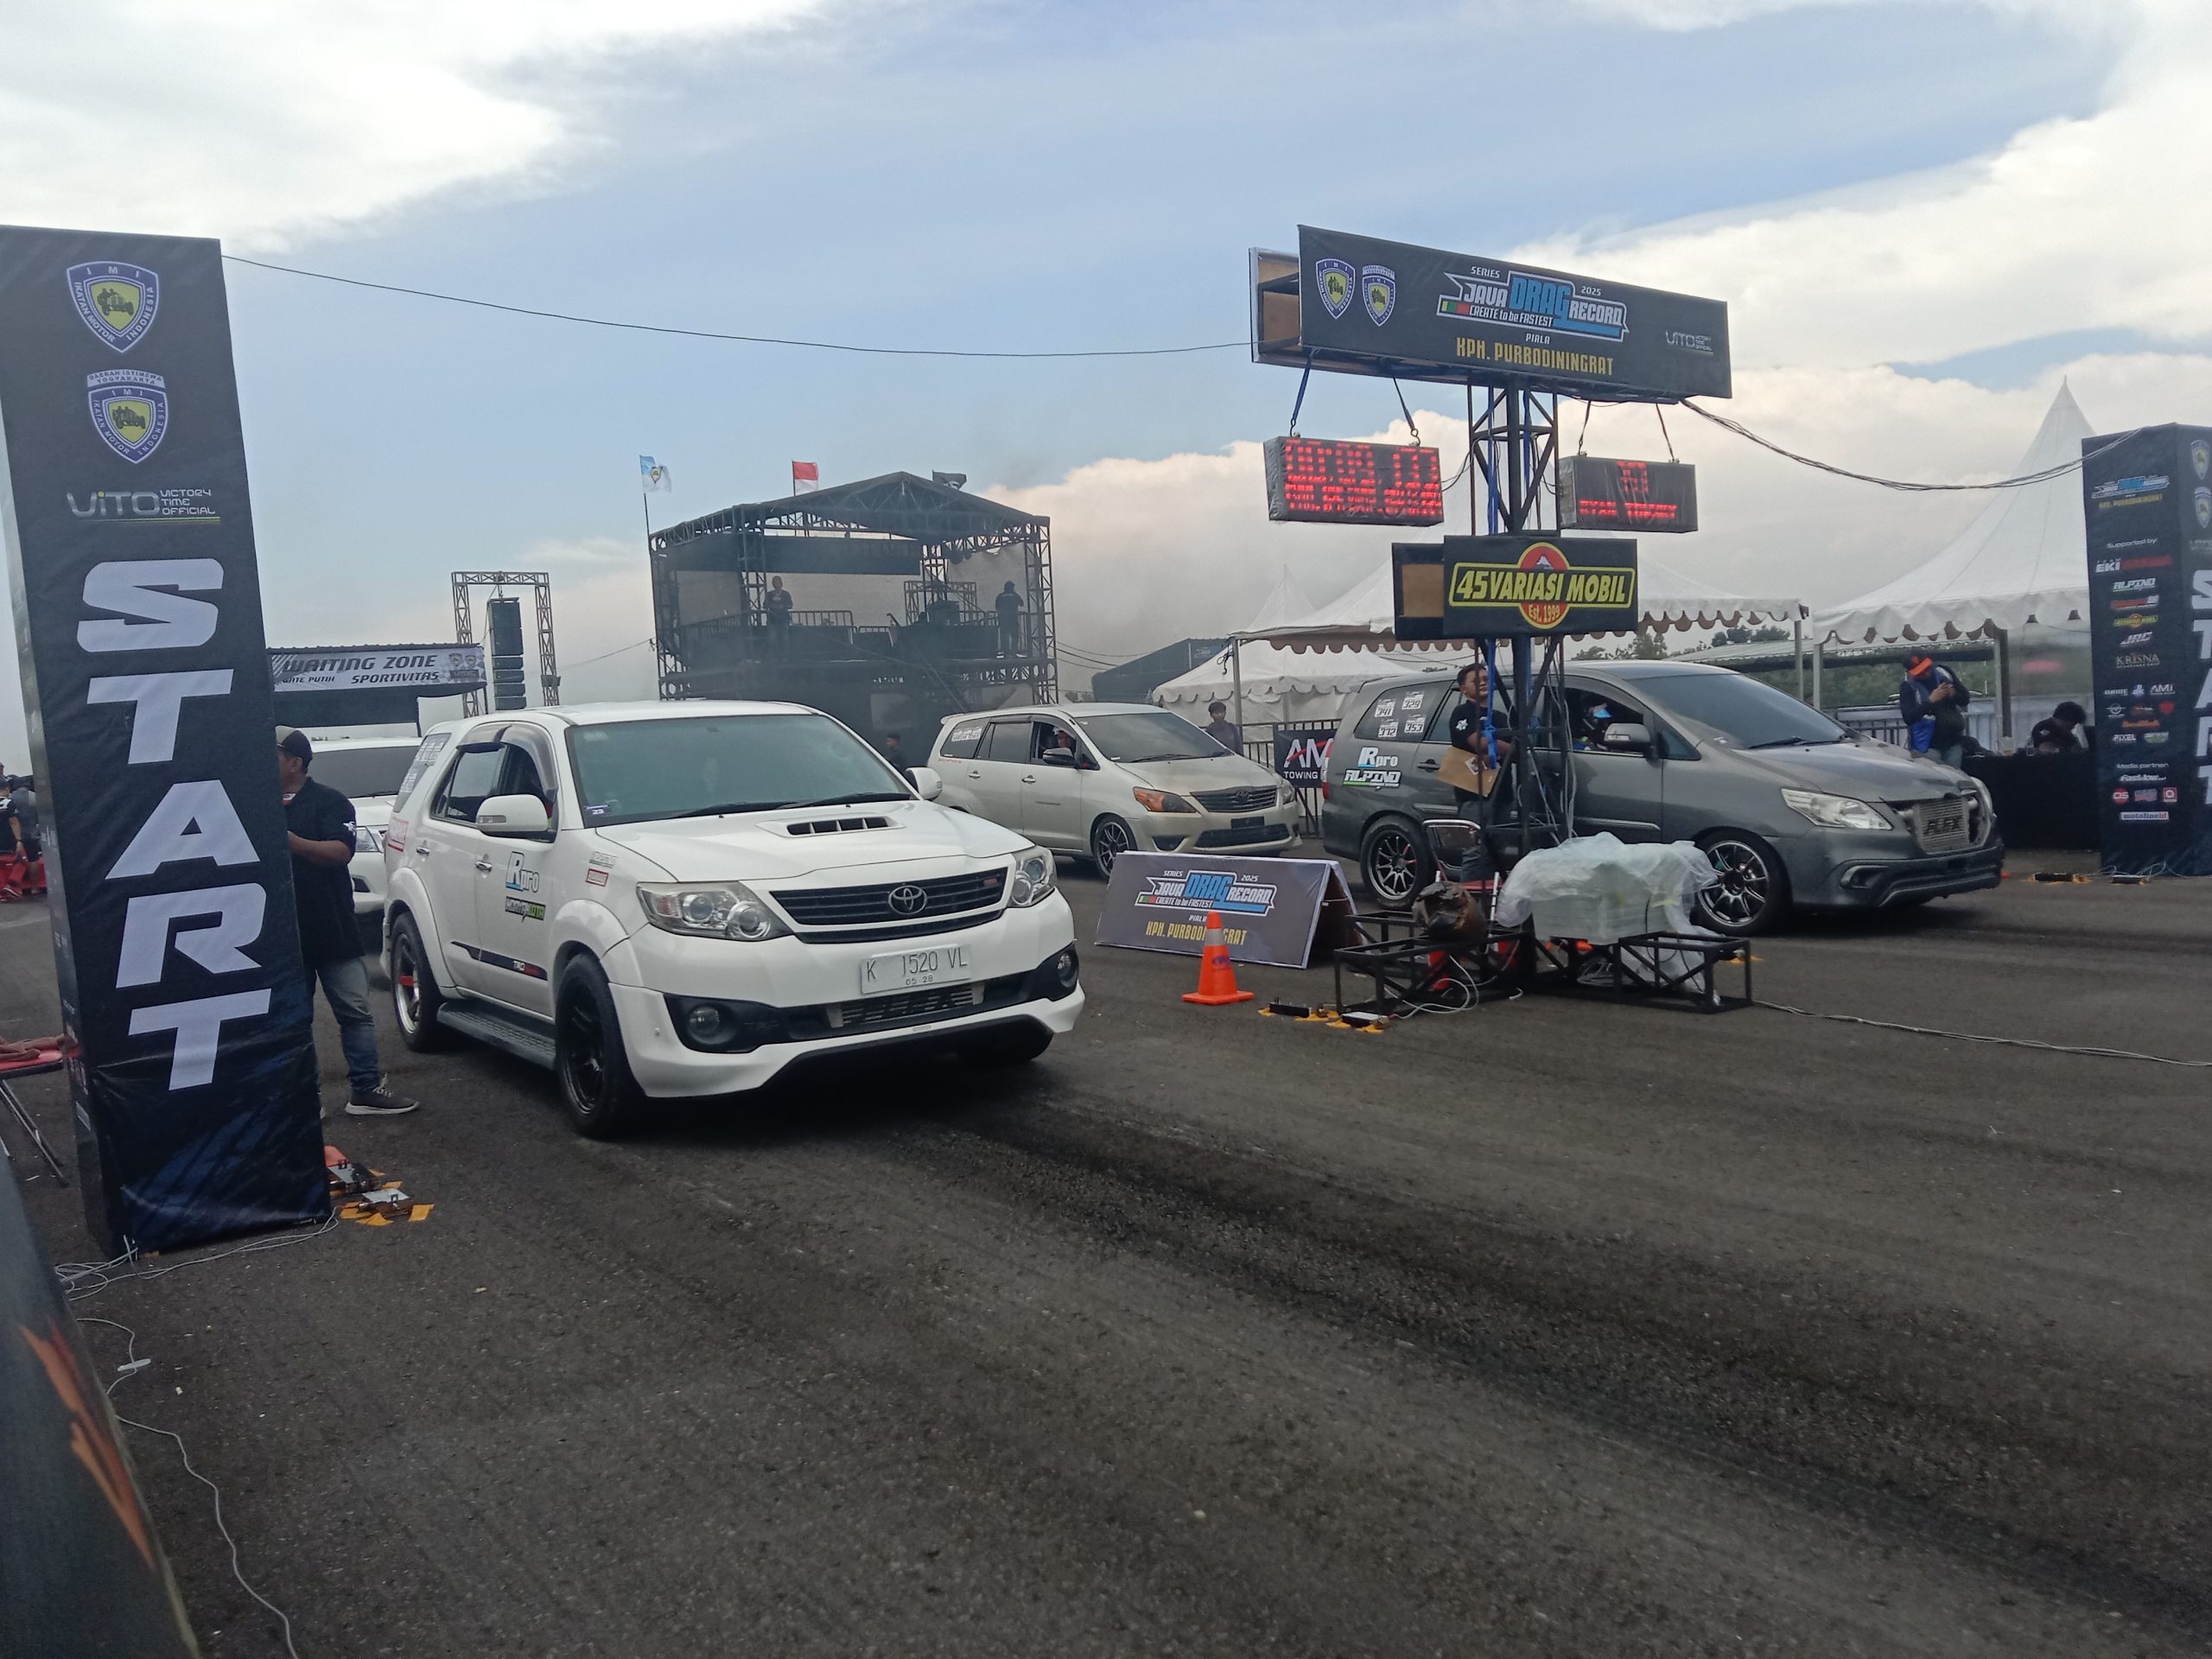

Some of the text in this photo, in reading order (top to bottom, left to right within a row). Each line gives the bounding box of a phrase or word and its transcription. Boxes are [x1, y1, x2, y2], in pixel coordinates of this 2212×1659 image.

[87, 266, 139, 278] IMI
[1471, 266, 1500, 278] SERIES
[1580, 285, 1601, 296] 2025
[1464, 276, 1623, 327] JAVA DRAG RECORD
[74, 282, 116, 342] IKATAN MOTOR
[126, 287, 154, 340] INDONESIA
[1469, 304, 1554, 327] CREATE to be FASTEST
[1526, 333, 1550, 345] PIALA
[1456, 337, 1614, 376] KPH. PURBODININGRAT
[90, 369, 162, 381] DAERAH ISTIMEWA
[97, 375, 156, 385] YOGYAKARTA
[92, 399, 130, 454] IKATAN MOTOR
[138, 402, 166, 455] INDONESIA
[160, 489, 212, 498] VICTORY
[162, 507, 216, 516] OFFICIAL
[2095, 561, 2120, 572] EKI
[1566, 574, 1625, 603] MOBIL
[1529, 605, 1560, 623] Est. 1999
[282, 654, 438, 673] WAITING ZONE
[2116, 653, 2160, 665] KRISNA
[351, 671, 439, 684] SPORTIVITAS
[1406, 723, 1423, 732] 353
[2113, 734, 2137, 742] PIXEL
[1357, 746, 1399, 768] Rpro
[1284, 771, 1319, 779] TOWING
[1344, 769, 1402, 783] ALPINO
[77, 558, 272, 1090] START
[505, 851, 540, 893] Rpro
[1154, 874, 1273, 904] JAVA DRAG RECORD
[1155, 897, 1175, 906] CREATE
[1188, 899, 1213, 908] FASTEST
[1146, 921, 1165, 937] KPH.
[867, 947, 968, 982] K 1520 VL
